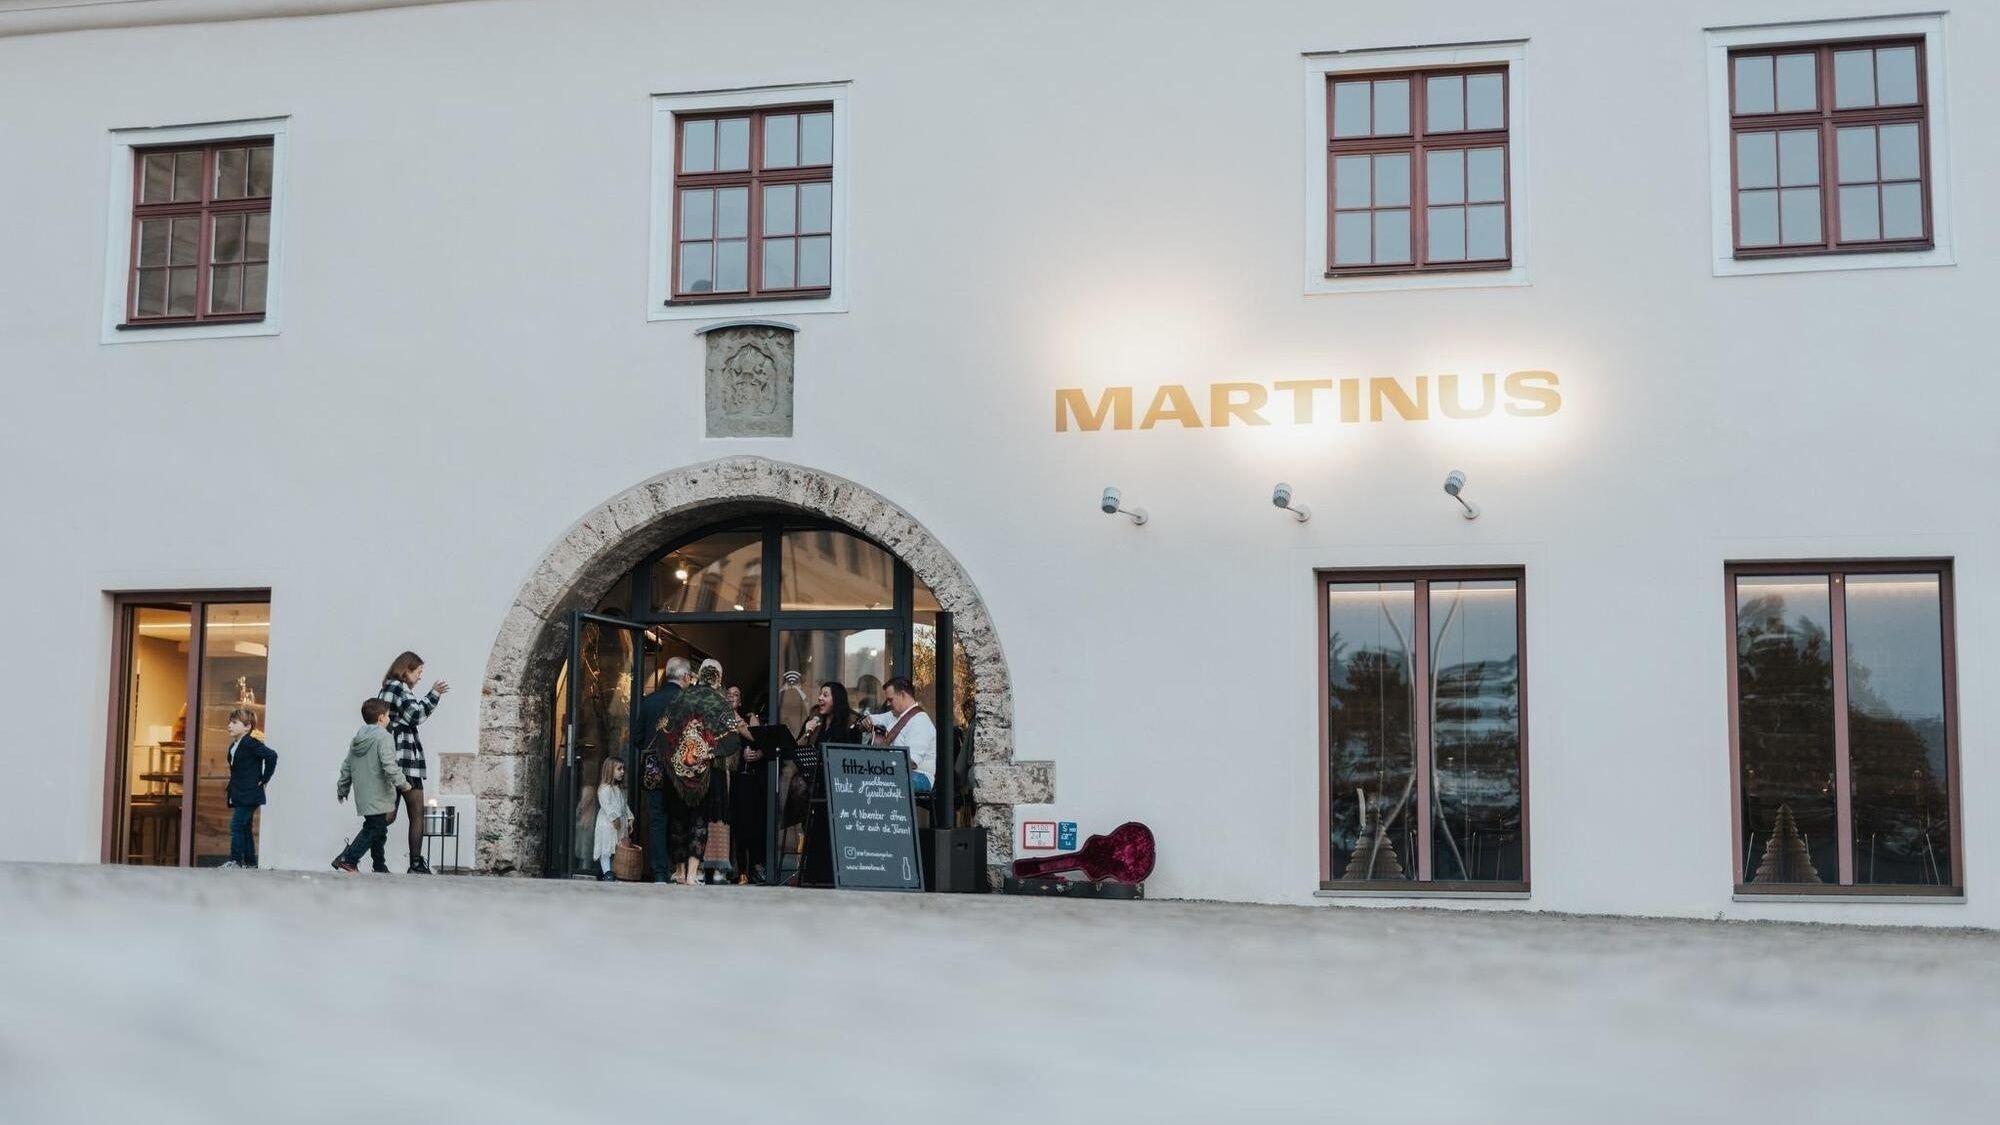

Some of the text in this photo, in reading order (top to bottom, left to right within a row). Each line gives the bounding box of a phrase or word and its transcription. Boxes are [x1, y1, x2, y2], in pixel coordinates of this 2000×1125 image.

[1054, 369, 1563, 433] MARTINUS
[841, 758, 895, 776] fritz-kola
[834, 777, 854, 793] Heute
[840, 808, 850, 819] Am
[859, 808, 885, 820] November
